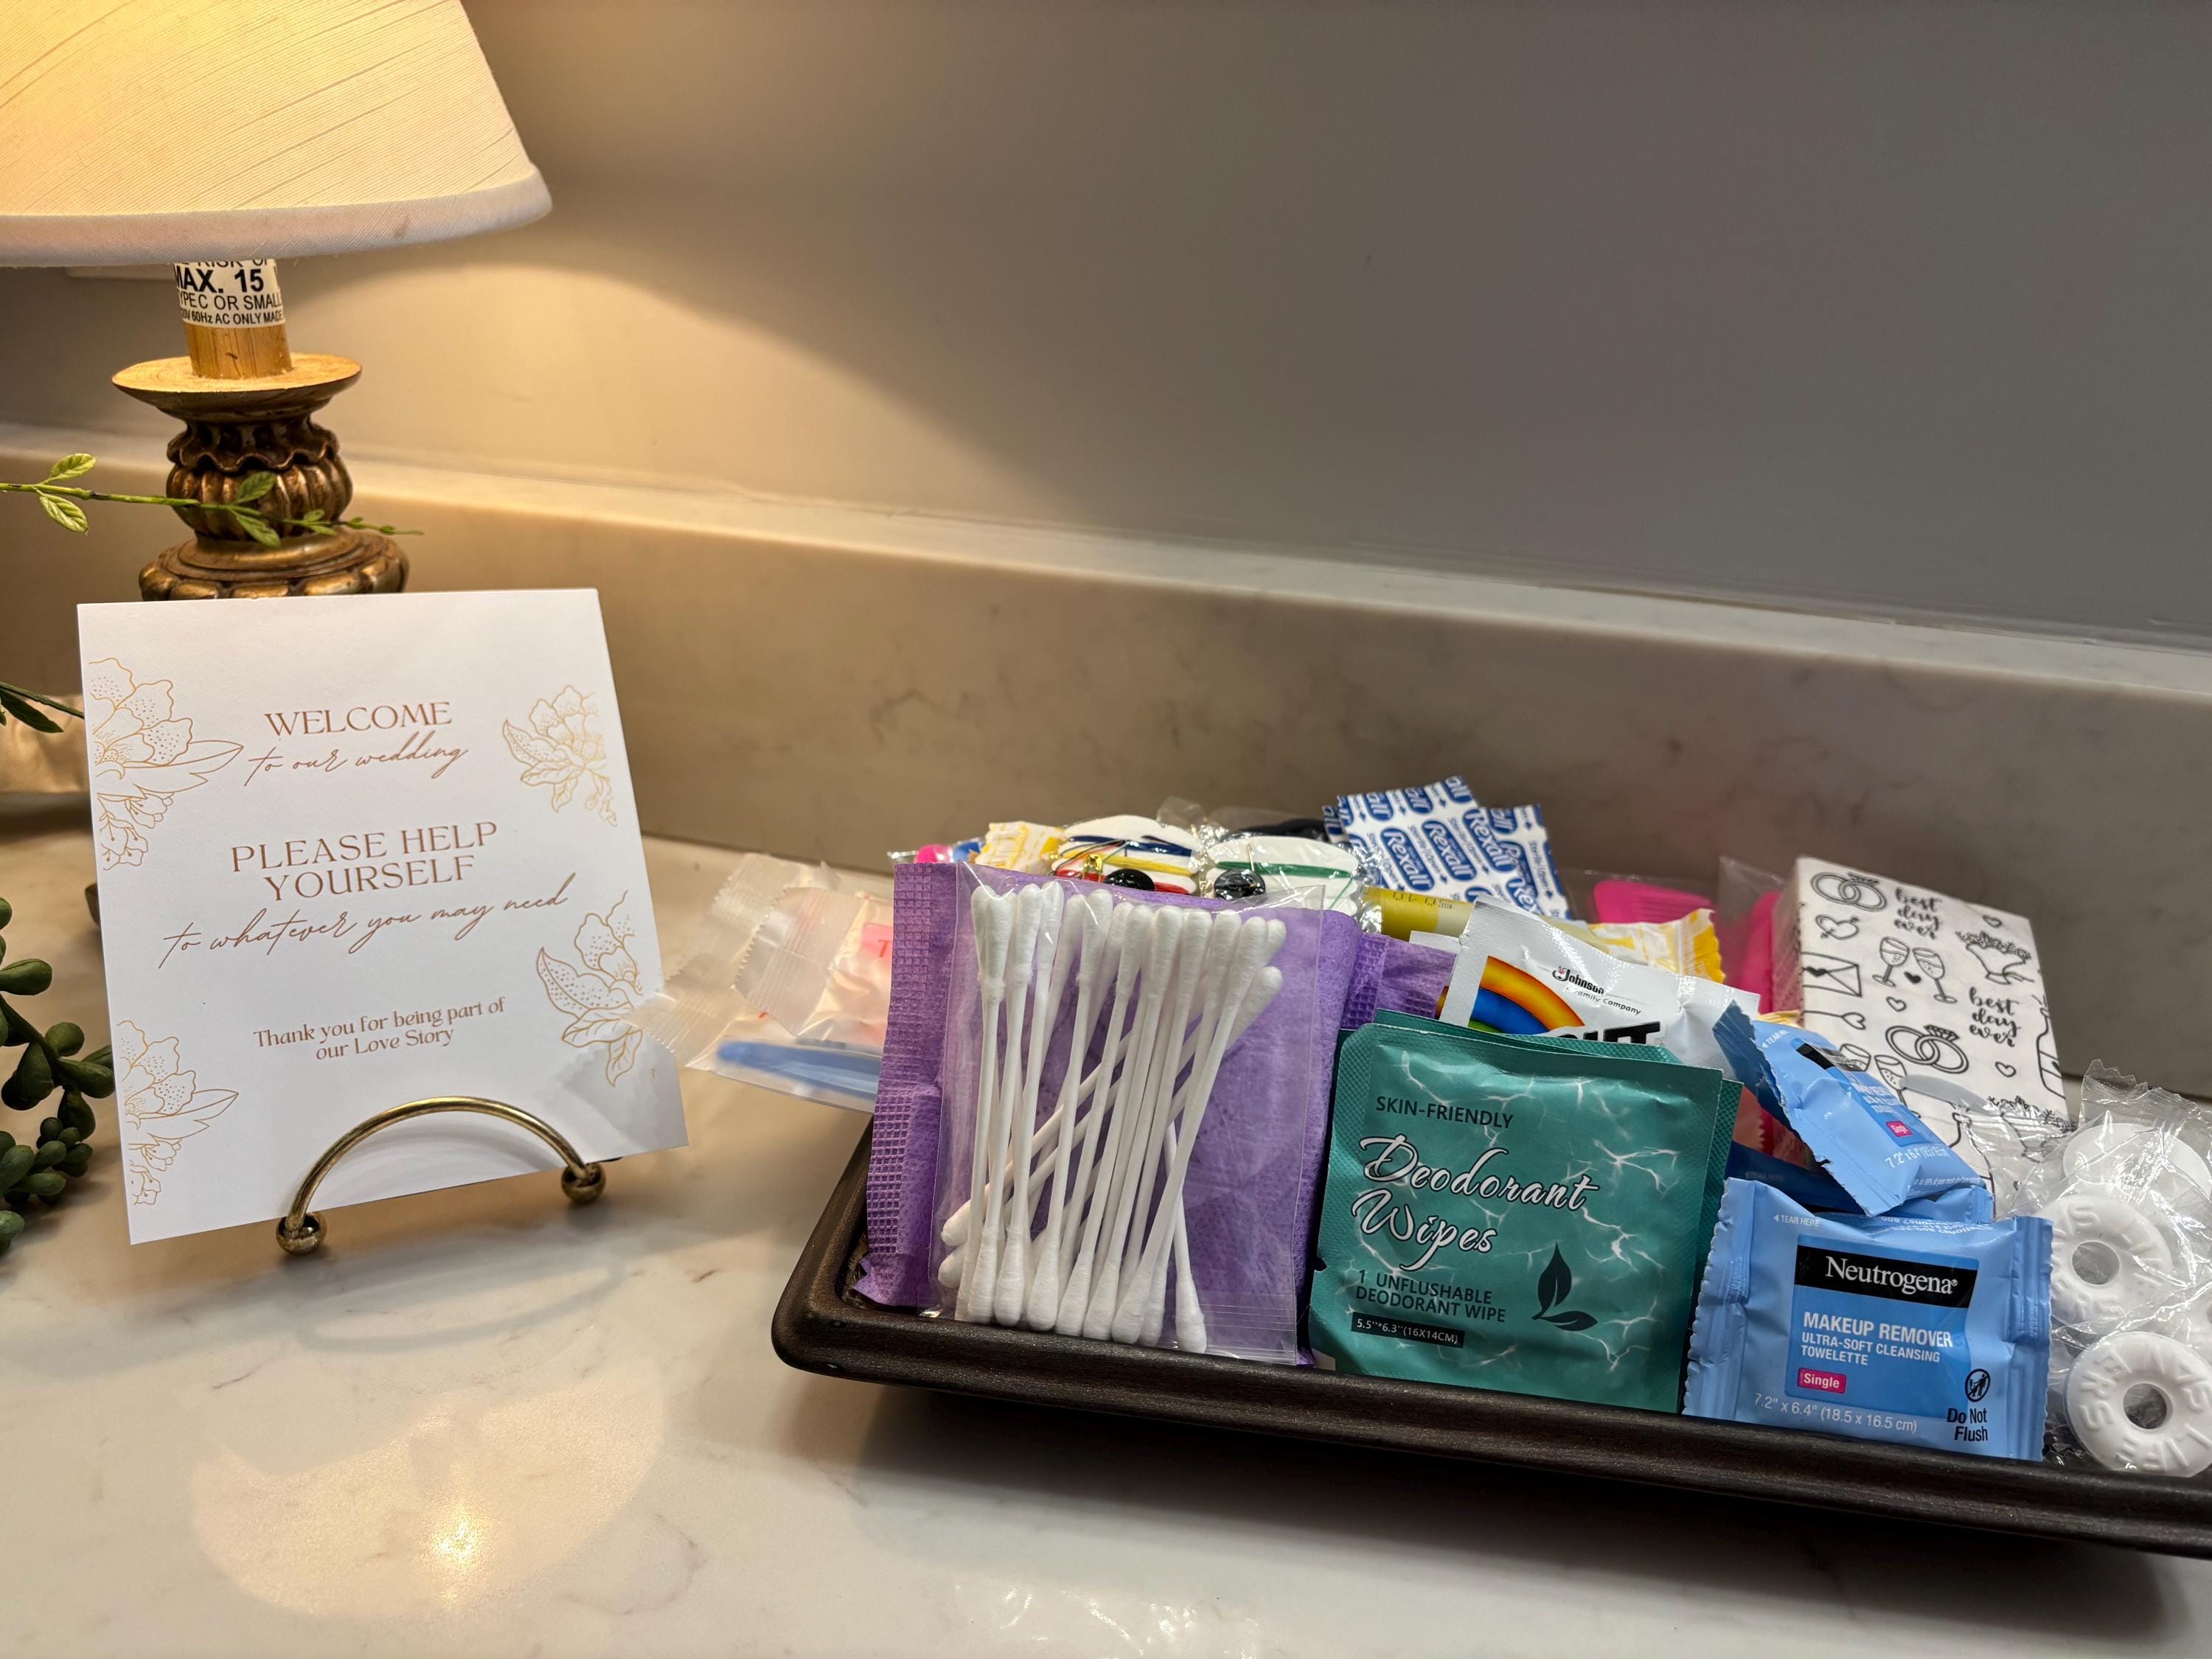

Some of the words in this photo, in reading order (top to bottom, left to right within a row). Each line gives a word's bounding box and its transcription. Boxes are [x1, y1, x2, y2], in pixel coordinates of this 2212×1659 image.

[234, 268, 264, 292] 15
[214, 295, 239, 310] OR
[215, 313, 230, 324] AC
[233, 312, 262, 324] ONLY
[265, 701, 452, 737] WELCOME
[244, 746, 284, 787] to
[292, 749, 349, 772] our
[355, 731, 470, 779] wedding
[231, 832, 388, 873] PLEASE
[401, 821, 498, 855] HELP
[1423, 822, 1473, 877] Rexall
[1464, 812, 1514, 868] Rexall
[1382, 831, 1429, 886] Rexall
[263, 855, 476, 902] YOURSELF
[1895, 887, 1943, 913] best
[159, 922, 202, 969] to
[209, 908, 360, 956] whatever
[348, 914, 423, 955] you
[431, 905, 495, 941] may
[502, 872, 577, 911] need
[1893, 919, 1937, 940] ever
[1897, 905, 1942, 931] day
[1552, 968, 1604, 995] Johnson
[1602, 998, 1642, 1016] Company
[1969, 986, 2020, 1015] best
[254, 1026, 316, 1049] Thank
[320, 1022, 355, 1043] you
[359, 1014, 388, 1033] for
[392, 1008, 444, 1027] being
[447, 1001, 483, 1026] part
[487, 997, 506, 1014] of
[1969, 1024, 2015, 1048] ever
[1972, 1008, 2022, 1038] day
[315, 1043, 350, 1060] our
[354, 1035, 400, 1056] Love
[406, 1027, 456, 1048] Story
[1375, 1096, 1514, 1130] SKIN-FRIENDLY
[1358, 1133, 1600, 1211] Deodorant
[1351, 1188, 1497, 1272] Wipes
[1780, 1214, 1799, 1225] TEAR
[1800, 1217, 1820, 1227] HERE
[1357, 1269, 1366, 1284] 1
[1376, 1273, 1492, 1305] UNFLUSHABLE
[1355, 1285, 1461, 1318] DEODORANT
[1465, 1302, 1506, 1323] WIPE
[1804, 1312, 1874, 1338] MAKEUP
[1879, 1323, 1953, 1349] REMOVER
[1801, 1331, 1873, 1353] ULTRA-SOFT
[1876, 1343, 1940, 1363] CLEANSING
[1801, 1345, 1868, 1366] TOWELETTE
[1804, 1373, 1840, 1389] Single
[1754, 1392, 1778, 1410] 7.2"
[1781, 1402, 1787, 1413] x
[1791, 1401, 1818, 1416] 6.4"
[1820, 1407, 1852, 1424] (18.5
[1855, 1415, 1863, 1425] x
[1866, 1413, 1893, 1429] 16.5
[1895, 1419, 1917, 1434] cm)
[1947, 1407, 1966, 1424] Do
[1969, 1407, 1988, 1424] Not
[1954, 1425, 1989, 1441] Flush
